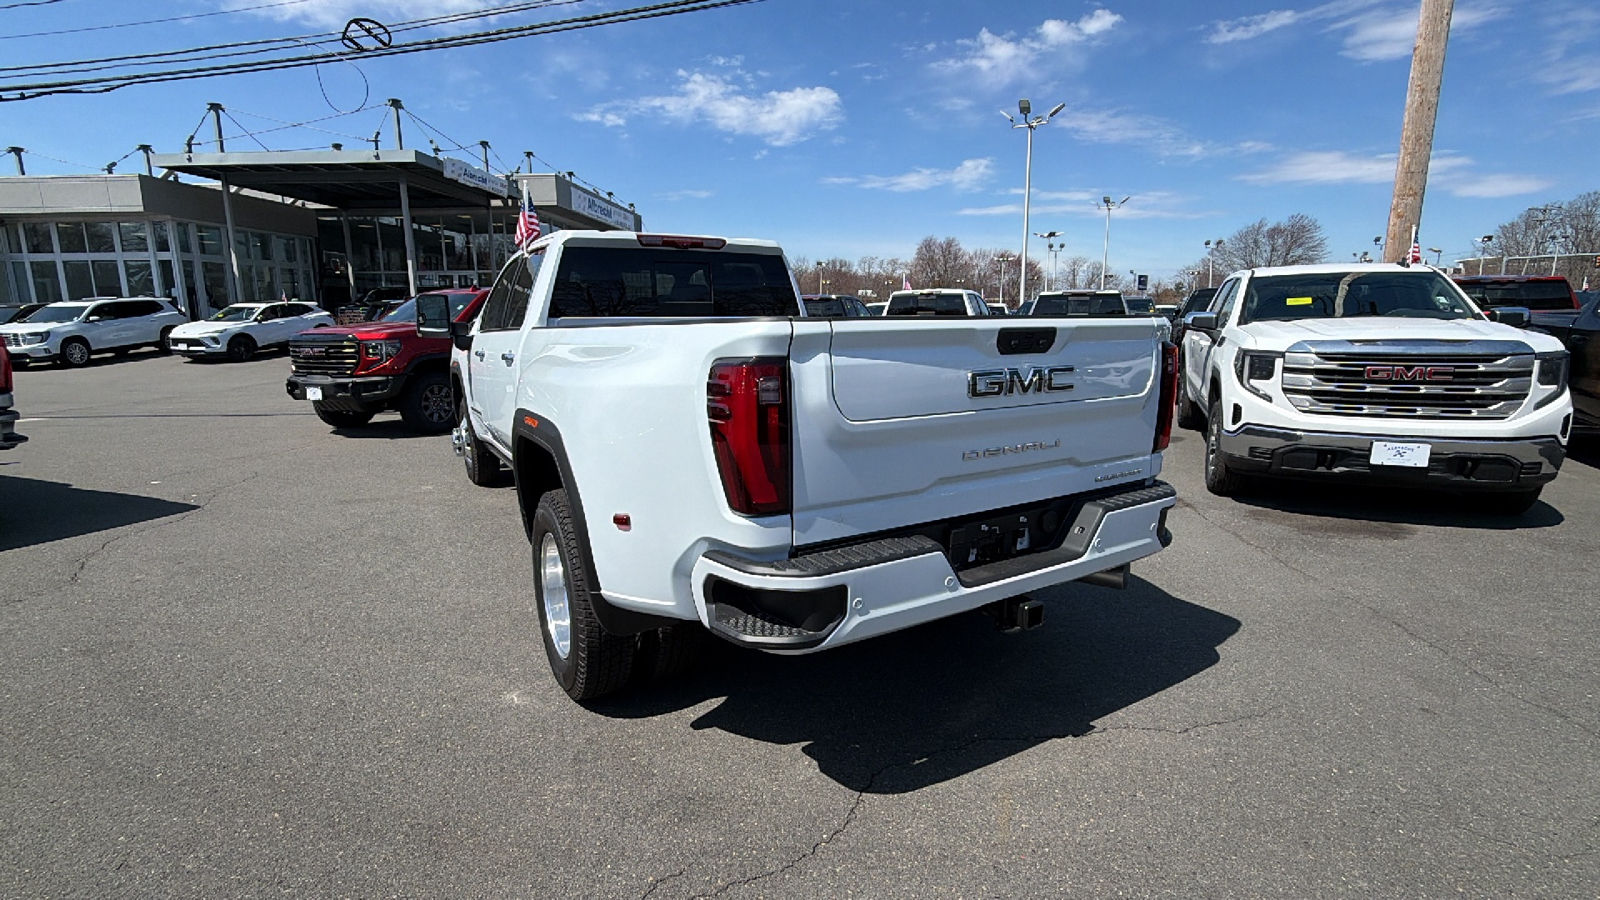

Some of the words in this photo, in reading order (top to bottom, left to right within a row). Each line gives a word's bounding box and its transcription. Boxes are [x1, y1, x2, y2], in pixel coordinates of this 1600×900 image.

[587, 197, 613, 219] Albrecht
[967, 365, 1075, 399] GMC
[1364, 366, 1455, 381] GMC
[962, 438, 1061, 461] DENALI
